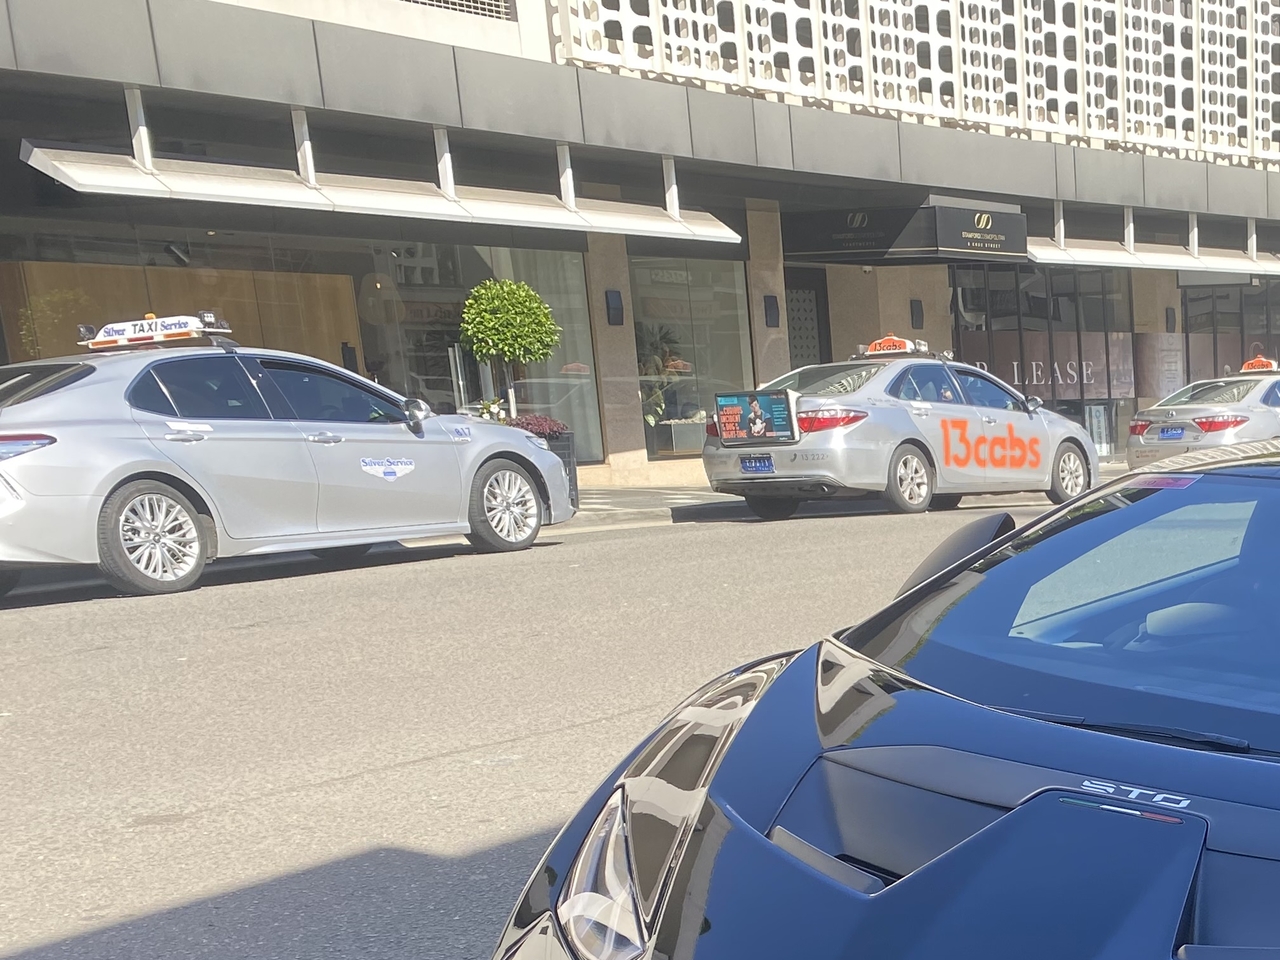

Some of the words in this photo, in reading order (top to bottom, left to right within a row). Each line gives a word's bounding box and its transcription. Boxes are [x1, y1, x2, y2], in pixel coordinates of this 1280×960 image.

[103, 326, 126, 337] Silver
[131, 321, 158, 334] TAXI
[160, 320, 189, 331] Service
[873, 342, 902, 352] 13cabs
[1247, 362, 1269, 370] 13cabs
[1012, 360, 1095, 386] LEASE
[454, 427, 471, 437] 817
[940, 417, 1041, 469] 13cabs
[361, 458, 384, 467] Silver
[385, 457, 414, 467] Service
[1080, 779, 1192, 808] STO
